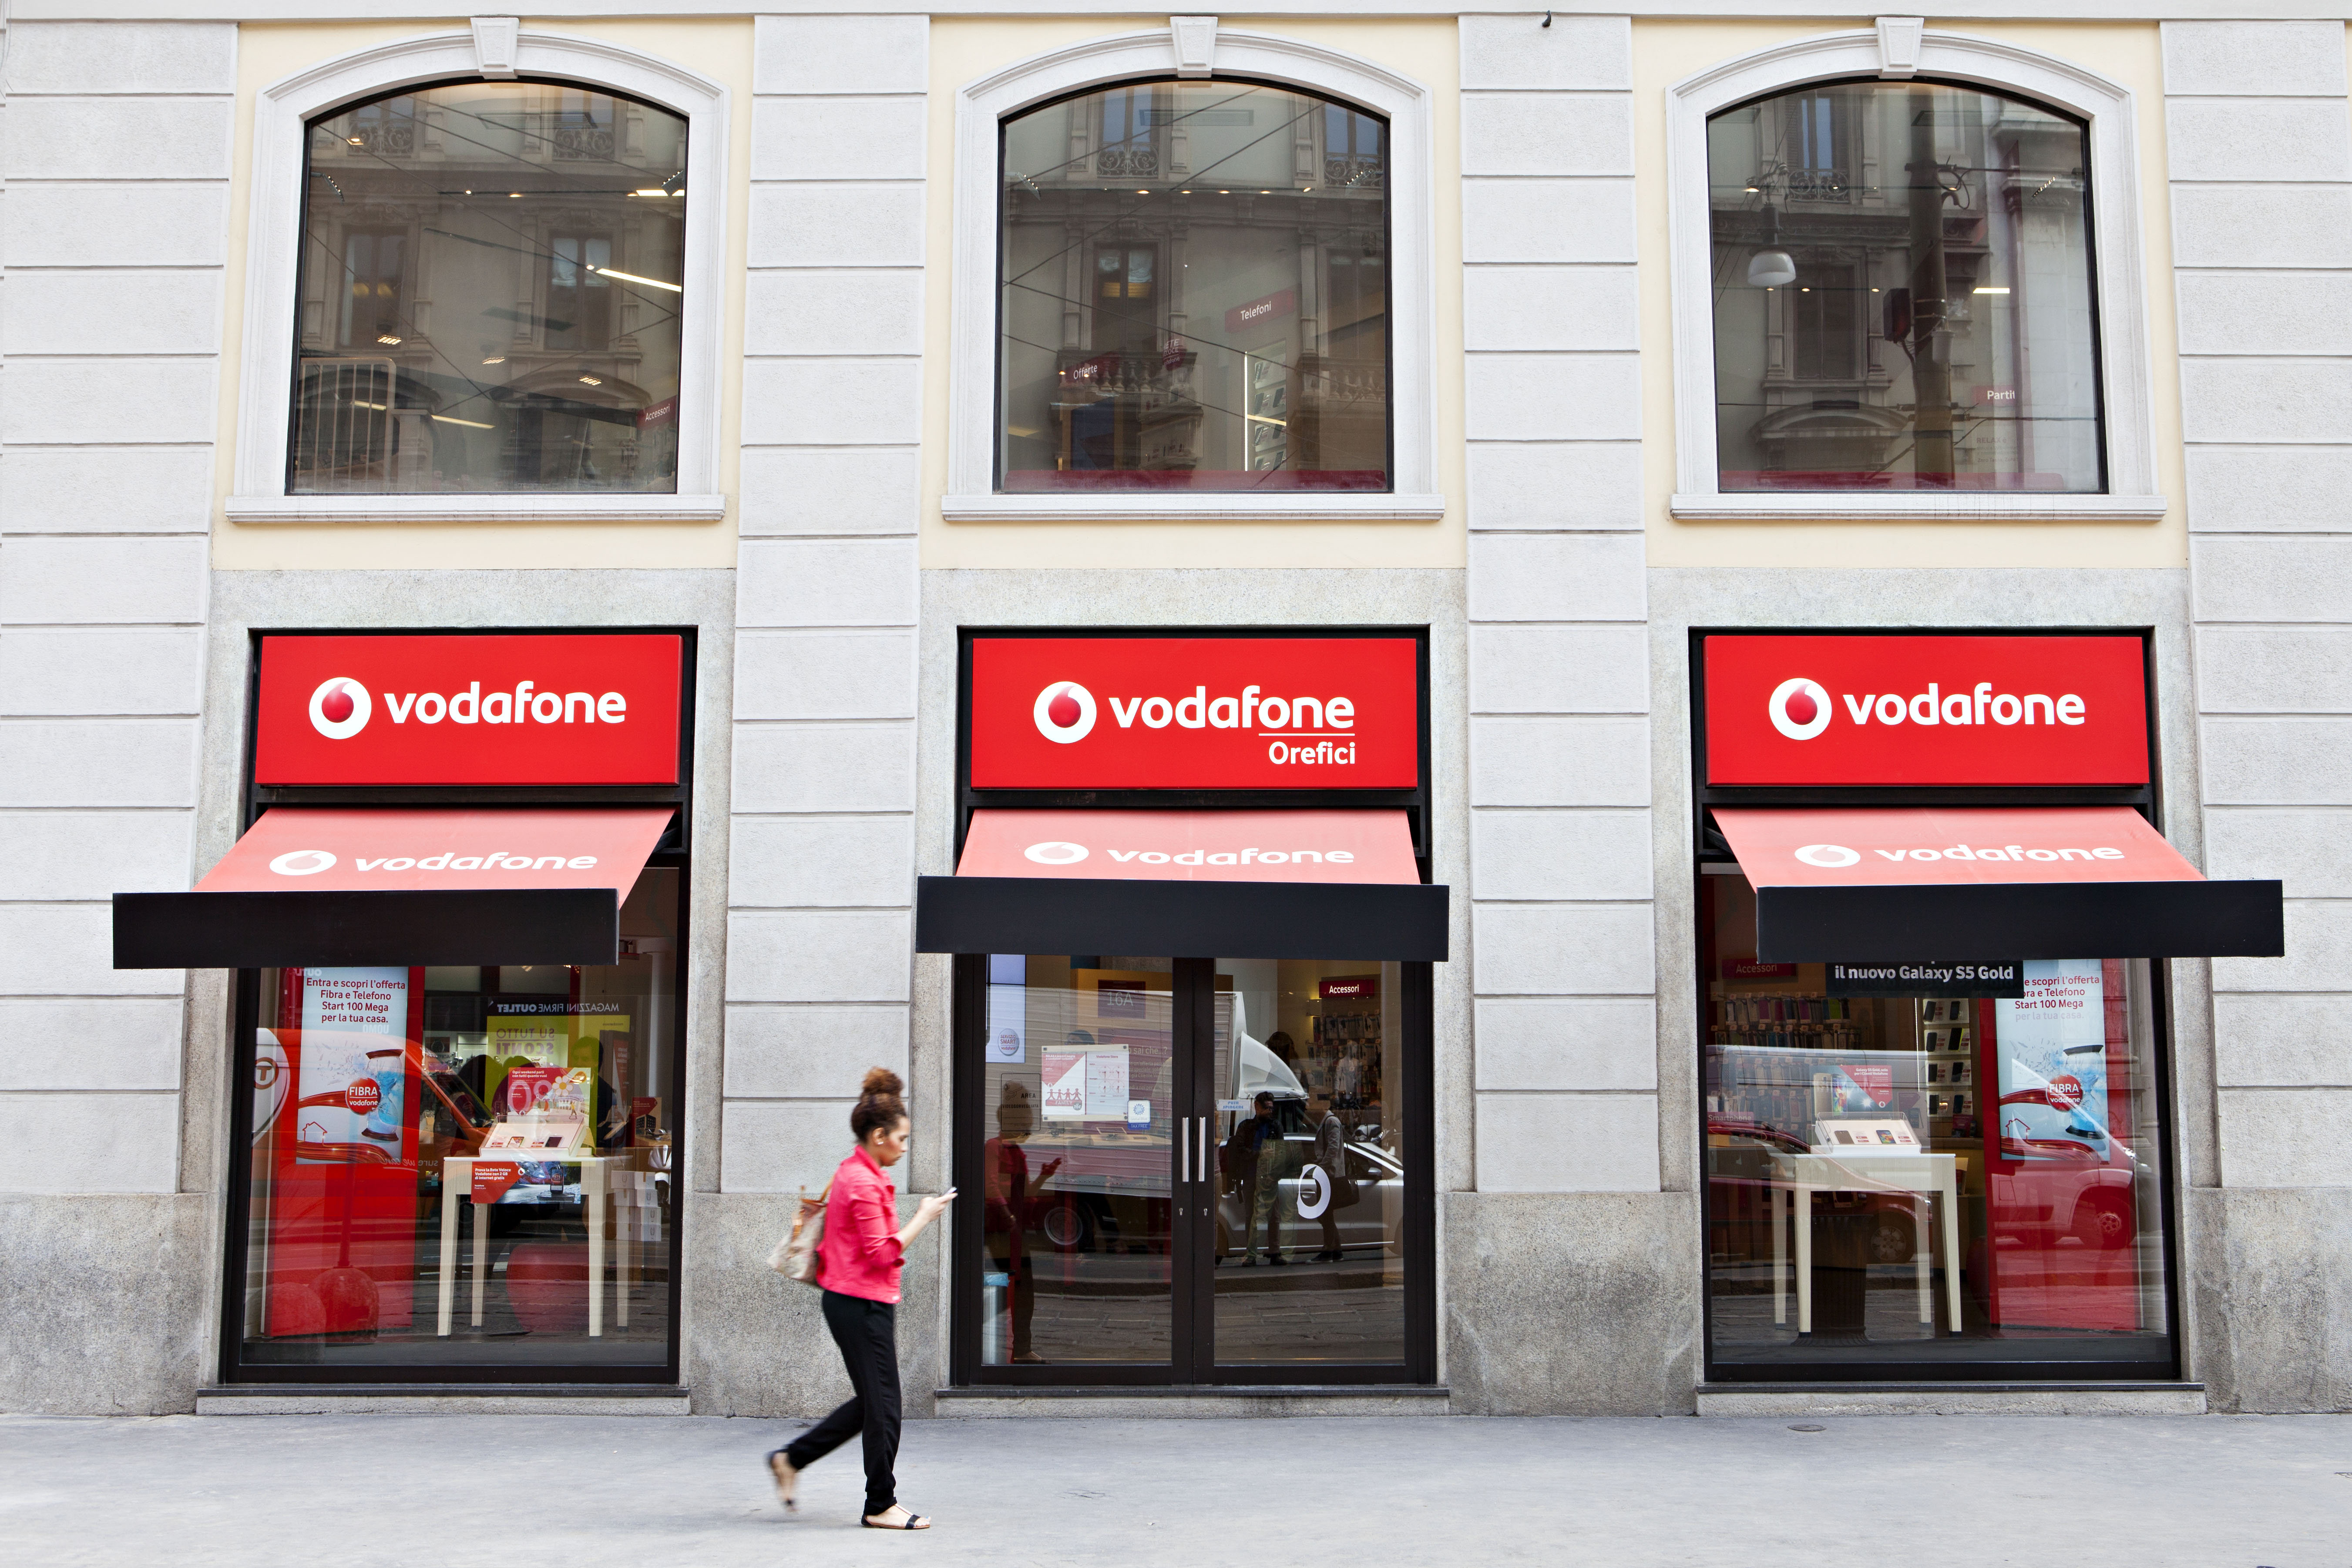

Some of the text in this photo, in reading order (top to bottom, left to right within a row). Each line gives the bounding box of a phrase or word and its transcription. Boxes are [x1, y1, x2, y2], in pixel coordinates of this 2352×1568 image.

[1240, 301, 1271, 320] Telefoni
[1073, 364, 1098, 379] Offerte
[645, 403, 670, 422] Accessori
[384, 681, 626, 724] vodafone
[1109, 685, 1354, 728] vodafone
[1843, 683, 2085, 725] vodafone
[1269, 742, 1355, 765] Orefici
[1107, 848, 1354, 865] vodafone
[1874, 844, 2124, 861] vodafone
[356, 852, 597, 871] vodafone
[1736, 964, 1777, 974] Accessori
[1835, 965, 2013, 982] il nuovo Galaxy S5 Gold
[306, 978, 331, 987] Entra
[341, 980, 368, 989] scopri
[370, 980, 405, 989] l'offerta
[2032, 977, 2059, 987] scopri
[2062, 976, 2099, 984] l'offerta
[321, 990, 343, 998] Fibra
[353, 991, 391, 1000] Telefono
[1329, 984, 1359, 994] Accessori
[2044, 987, 2085, 997] Telefono
[1107, 992, 1133, 1006] 16A
[2015, 999, 2083, 1010] Start 100 Mega
[322, 1002, 389, 1013] Start 100 Mega
[322, 1014, 336, 1023] per
[2016, 1014, 2030, 1023] per
[2033, 1011, 2041, 1020] la
[1133, 1045, 1144, 1054] sai
[349, 1086, 377, 1096] FIBRA
[2050, 1083, 2079, 1093] FIBRA
